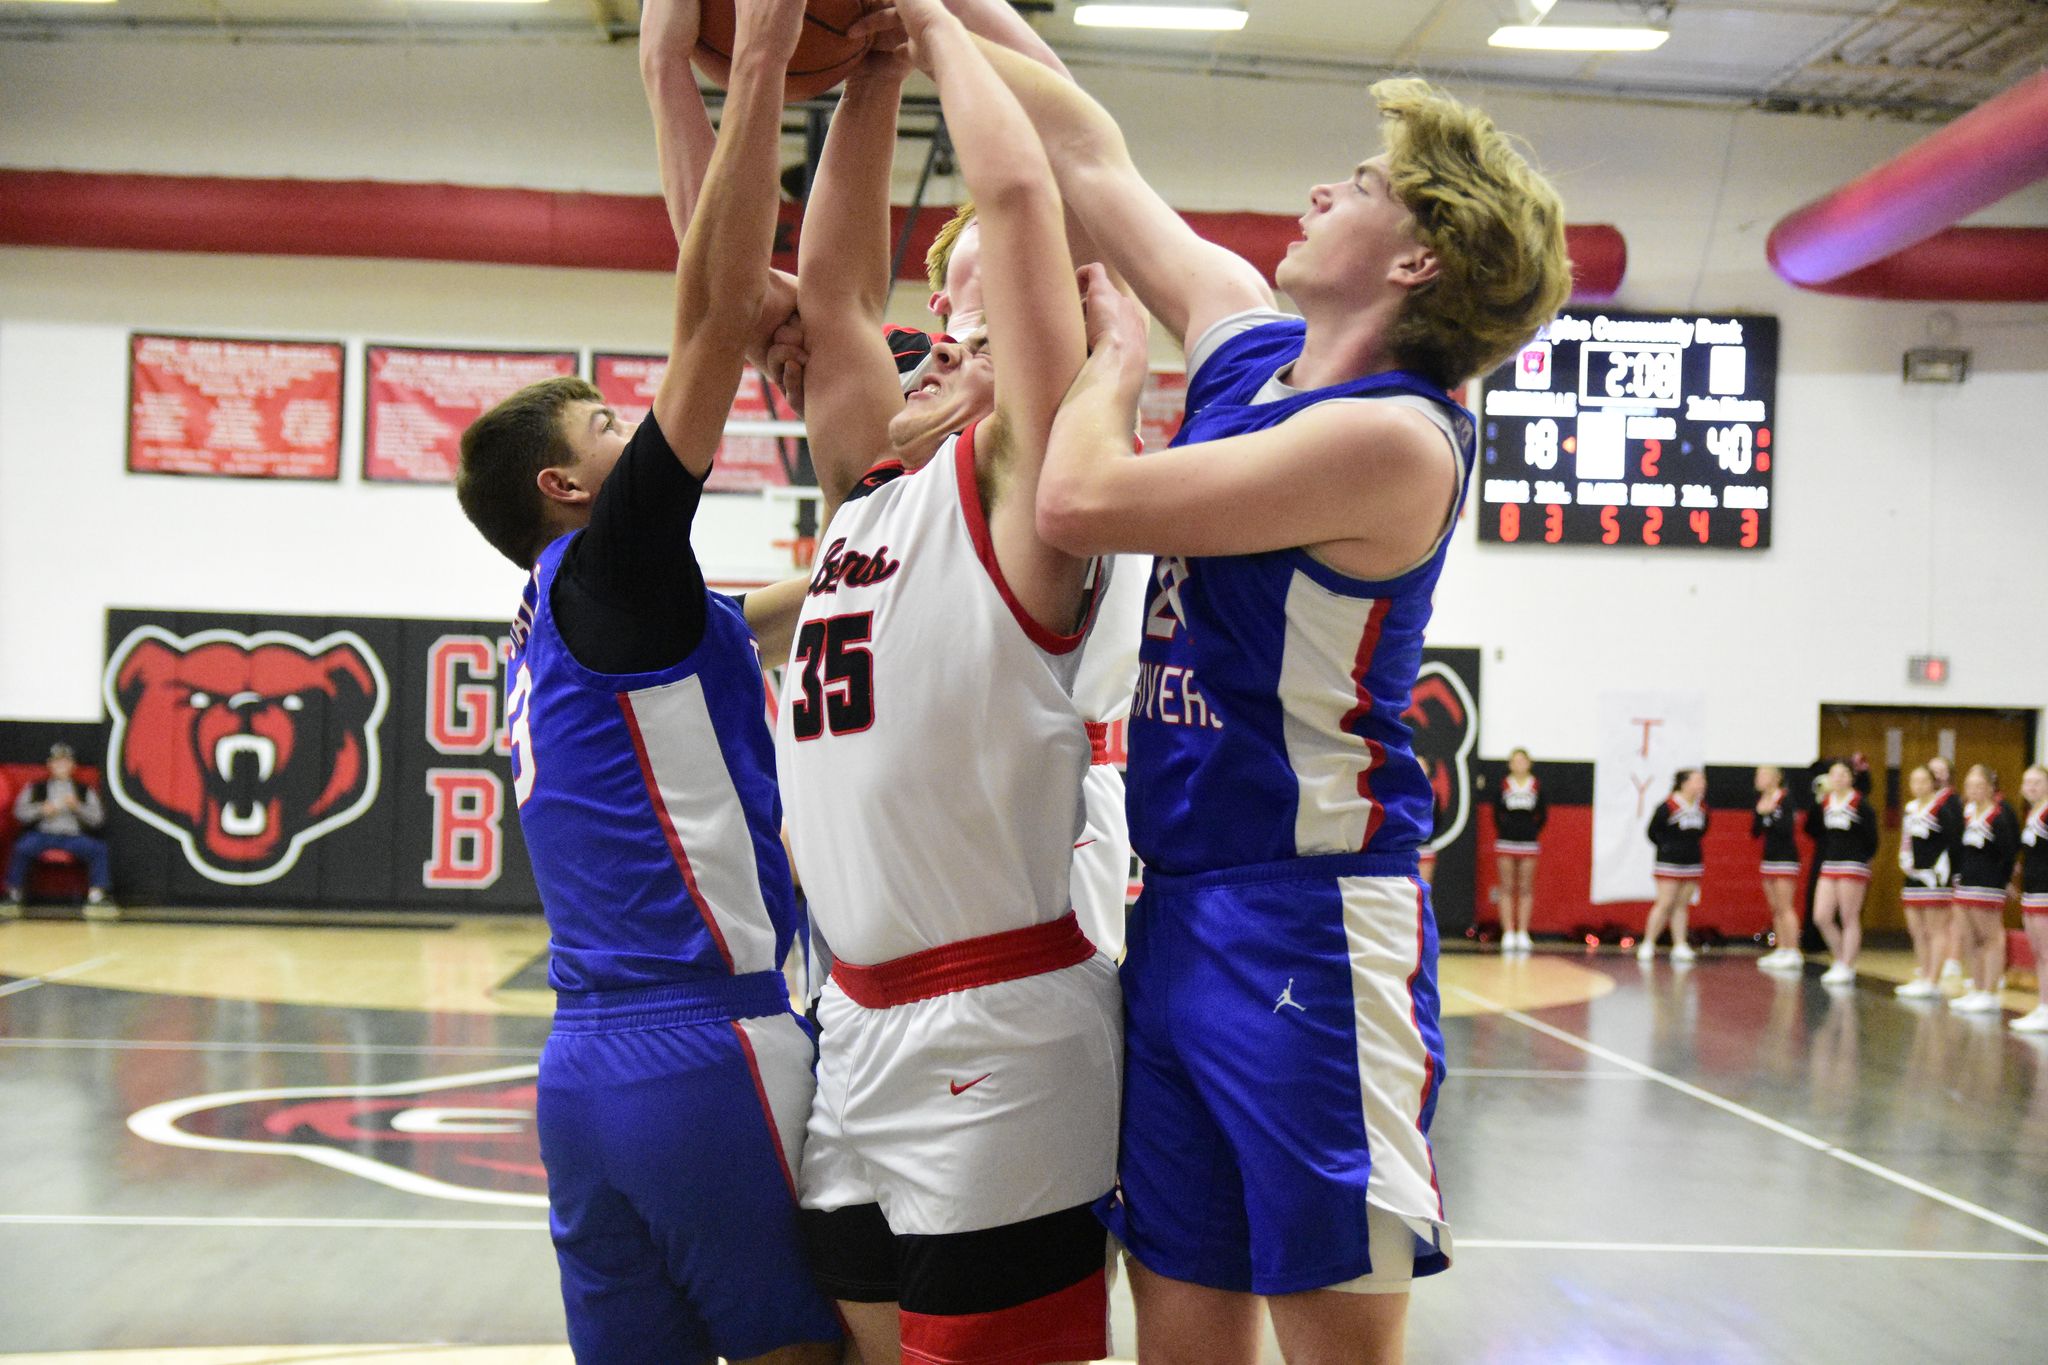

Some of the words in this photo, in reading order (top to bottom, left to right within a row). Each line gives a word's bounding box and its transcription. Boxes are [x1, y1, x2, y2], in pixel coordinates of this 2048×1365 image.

[1605, 351, 1675, 399] 2:08
[1641, 438, 1661, 477] 2
[1706, 423, 1753, 475] 40
[1545, 503, 1563, 544] 3
[1600, 505, 1620, 545] 5
[1642, 506, 1663, 546] 2
[1689, 510, 1709, 544] 4
[1740, 508, 1759, 548] 3
[792, 610, 876, 742] 35
